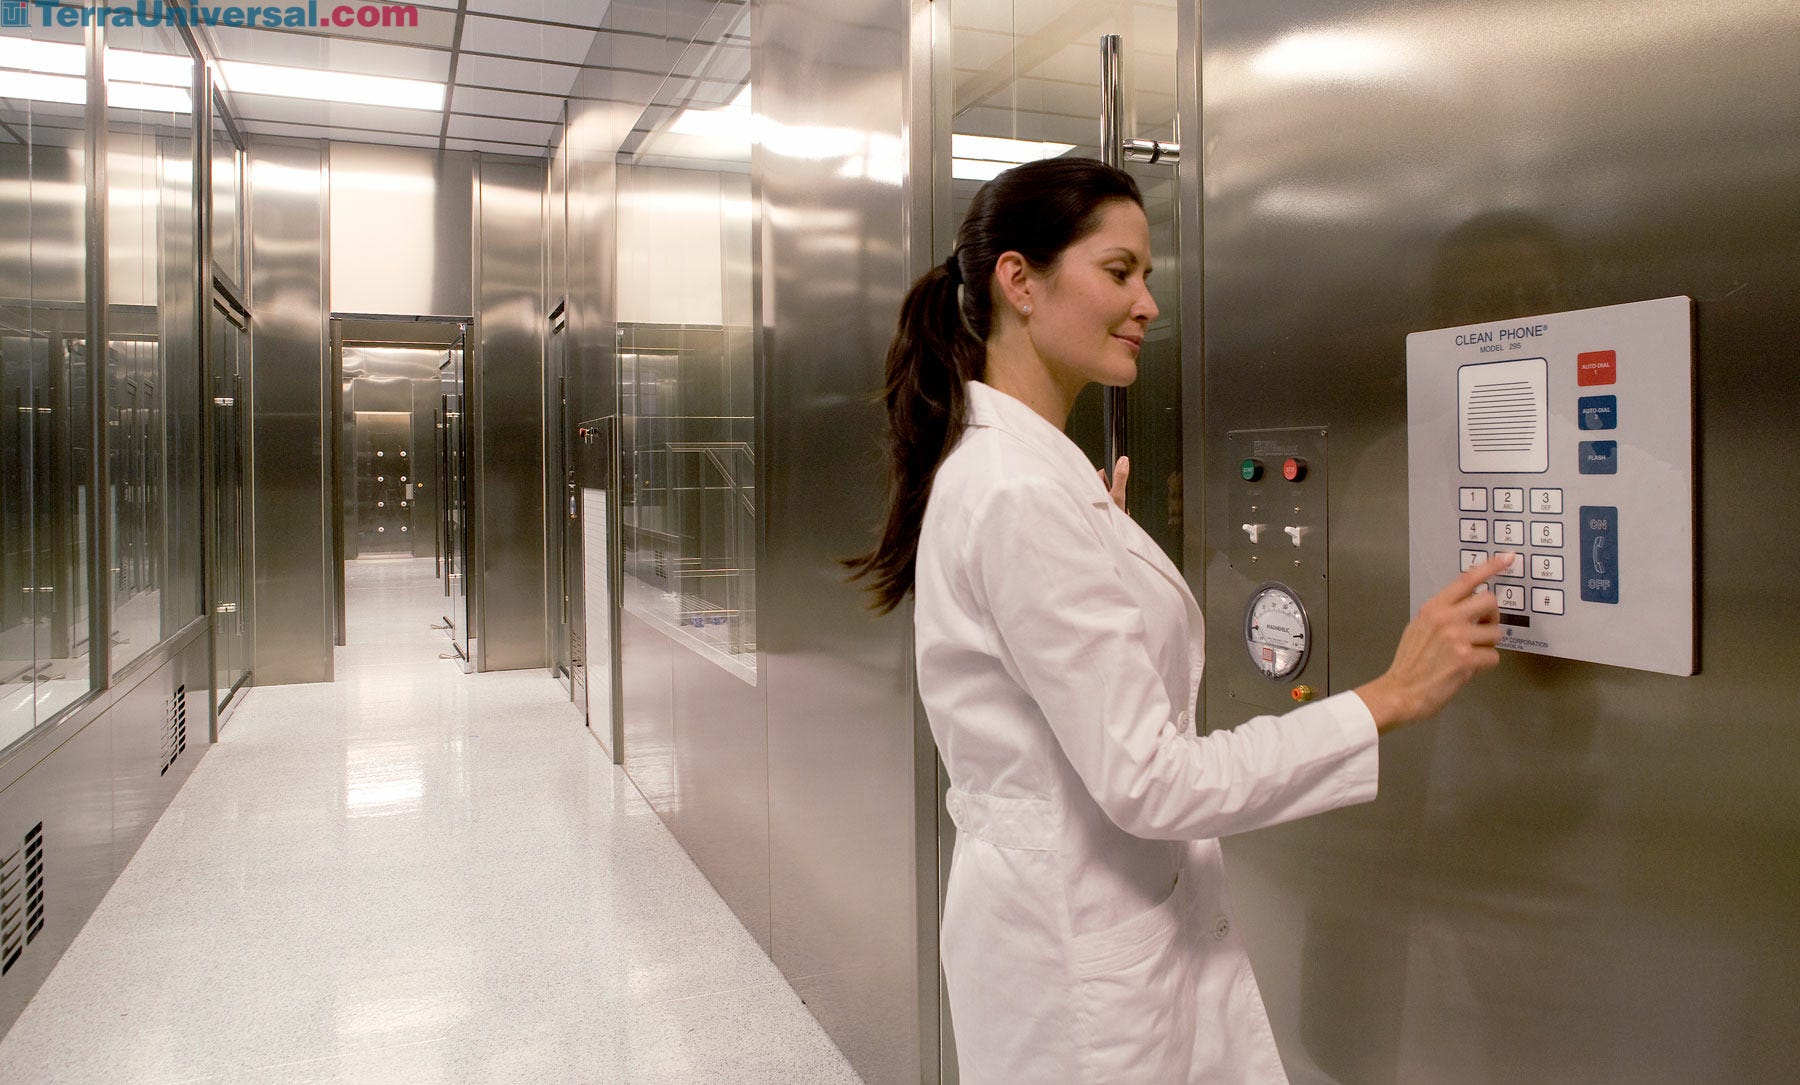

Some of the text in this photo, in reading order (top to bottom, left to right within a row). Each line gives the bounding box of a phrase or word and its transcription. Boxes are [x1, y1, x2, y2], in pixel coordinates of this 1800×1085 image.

[1455, 331, 1493, 346] CLEAN
[1480, 344, 1504, 353] MODEL
[1470, 491, 1475, 502] 1
[1504, 491, 1512, 503] 2
[1542, 492, 1550, 503] 3
[1470, 522, 1476, 533] 4
[1504, 524, 1512, 535] 5
[1589, 519, 1607, 530] ON
[1542, 525, 1550, 537] 6
[1471, 553, 1477, 564] 7
[1543, 558, 1550, 570] 9
[1587, 579, 1611, 591] OFF
[1506, 588, 1513, 599] 0
